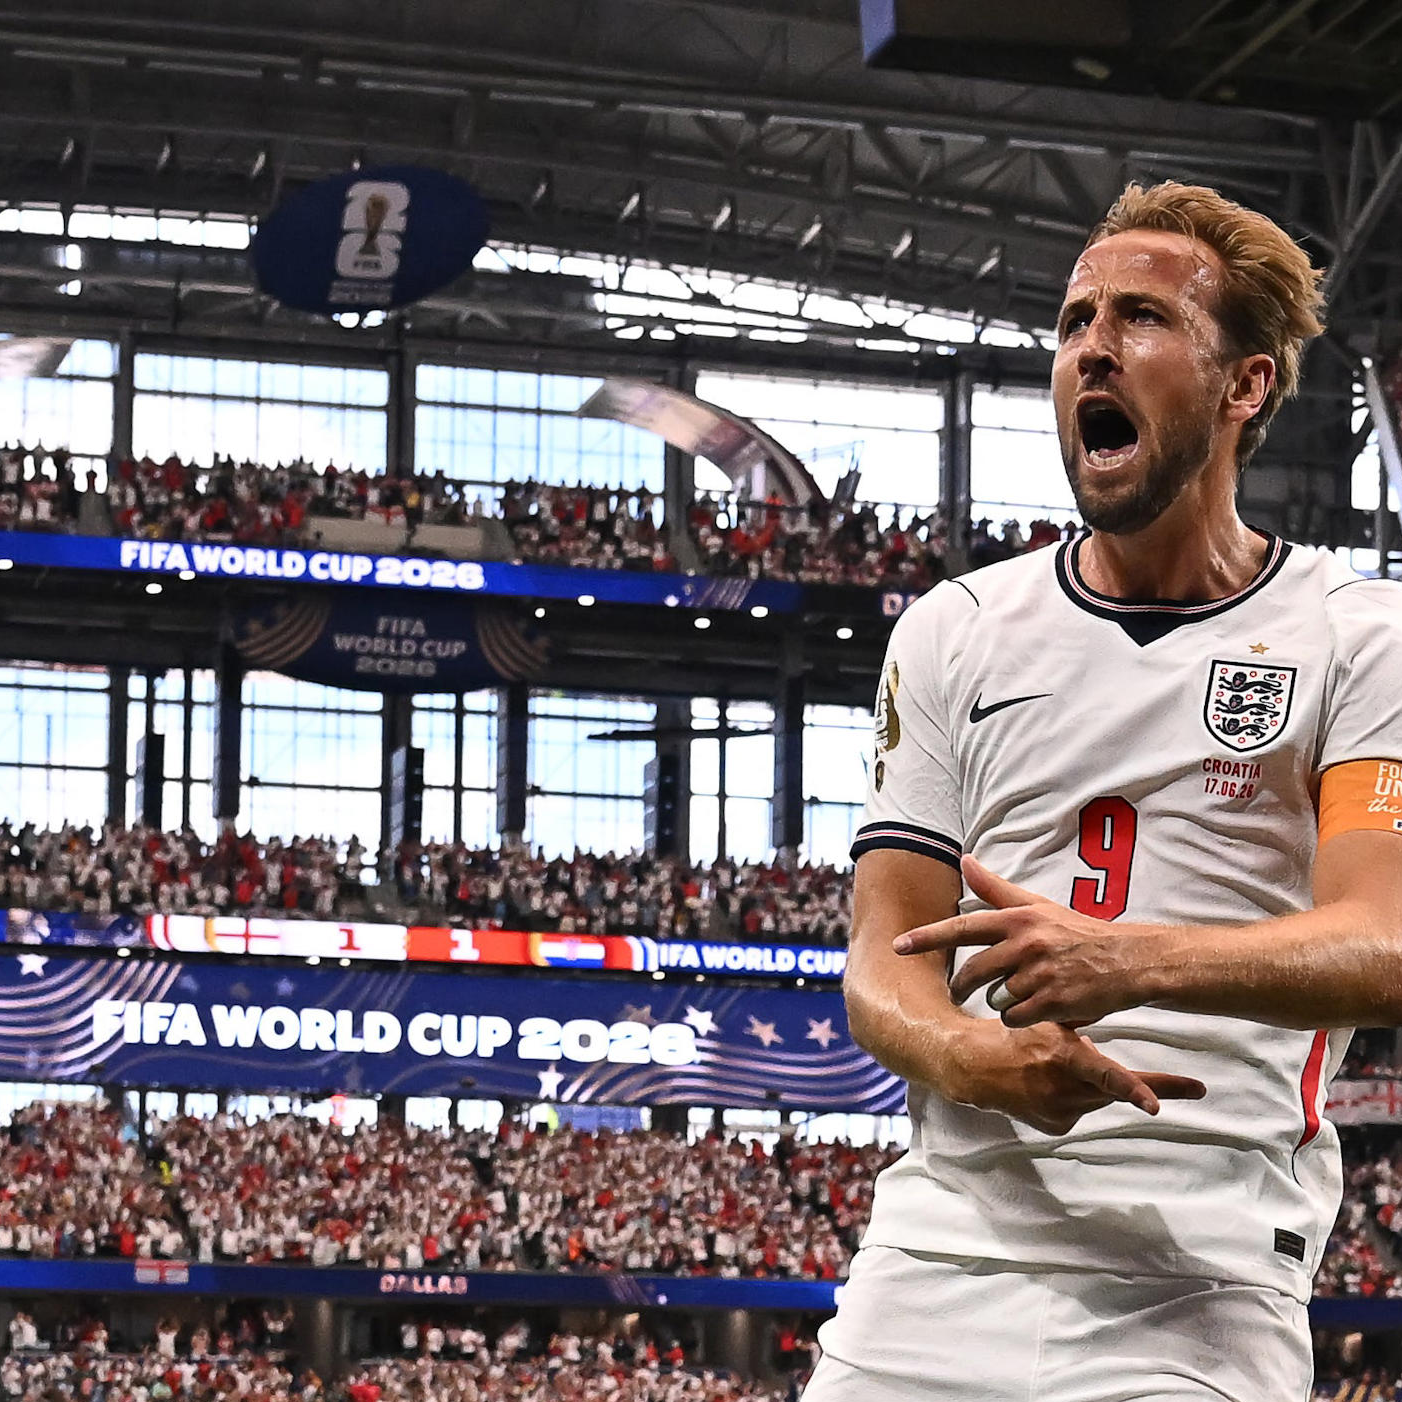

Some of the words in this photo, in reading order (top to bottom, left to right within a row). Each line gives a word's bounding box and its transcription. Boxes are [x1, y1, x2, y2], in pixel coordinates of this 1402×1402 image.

[120, 540, 190, 571] FIFA
[191, 543, 306, 578] WORLD
[307, 552, 373, 582] CUP
[375, 557, 486, 590] 2026
[377, 616, 426, 637] FIFA
[333, 634, 416, 656] WORLD
[421, 640, 466, 657] CUP
[1202, 758, 1262, 779] CROATIA
[1204, 777, 1255, 799] 17.06.26
[1366, 797, 1402, 813] the
[1070, 795, 1139, 922] 9
[339, 928, 361, 951] 1
[450, 929, 480, 961] 1
[658, 943, 700, 968] IFA
[701, 945, 796, 972] WORLD
[93, 1000, 207, 1046] FIFA
[209, 1004, 402, 1054] WORLD
[406, 1011, 513, 1058] CUP
[517, 1015, 698, 1066] 2026
